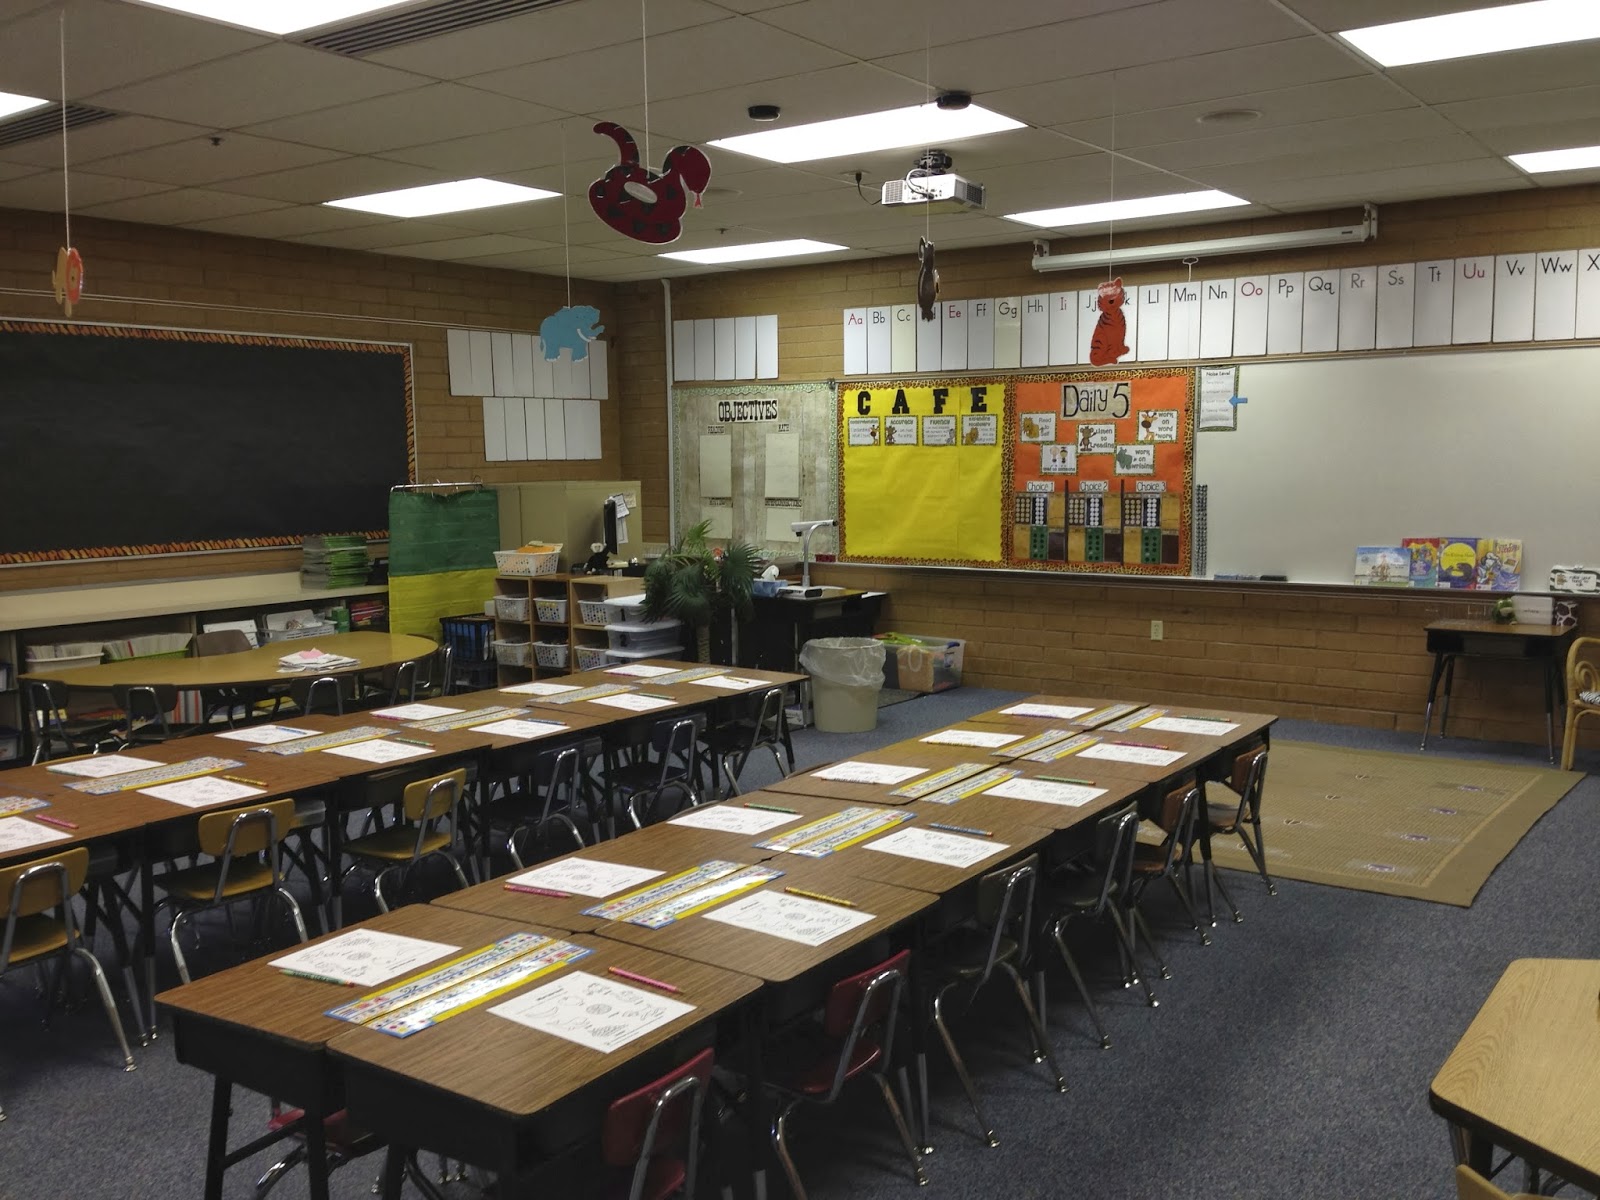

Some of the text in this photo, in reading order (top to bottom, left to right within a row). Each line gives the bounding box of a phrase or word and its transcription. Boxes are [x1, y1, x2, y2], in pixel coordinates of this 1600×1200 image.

[848, 313, 863, 325] Aa
[872, 311, 886, 324] Bb
[896, 309, 911, 322] Cc
[949, 305, 962, 318] Ee
[976, 303, 987, 316] Ff
[998, 302, 1018, 319] Gg
[1027, 299, 1044, 313] Hh
[1060, 297, 1067, 311] Ii
[1086, 295, 1097, 312] Jj
[1173, 287, 1197, 302] Mm
[1208, 284, 1228, 300] Nn
[1240, 281, 1263, 296] Oo
[1278, 278, 1294, 298] Pp
[1308, 276, 1335, 295] Qq
[1351, 273, 1365, 289] Rr
[1387, 270, 1404, 286] Ss
[1428, 266, 1441, 282] Tt
[1463, 263, 1485, 279] Uu
[1506, 260, 1525, 276] Vv
[1541, 257, 1573, 274] Ww
[1063, 382, 1130, 418] Daily 5
[718, 400, 778, 422] OBJECTIVES
[1027, 481, 1048, 492] Choice
[1080, 481, 1108, 492] Choice 2
[1136, 481, 1166, 492] Choice 3
